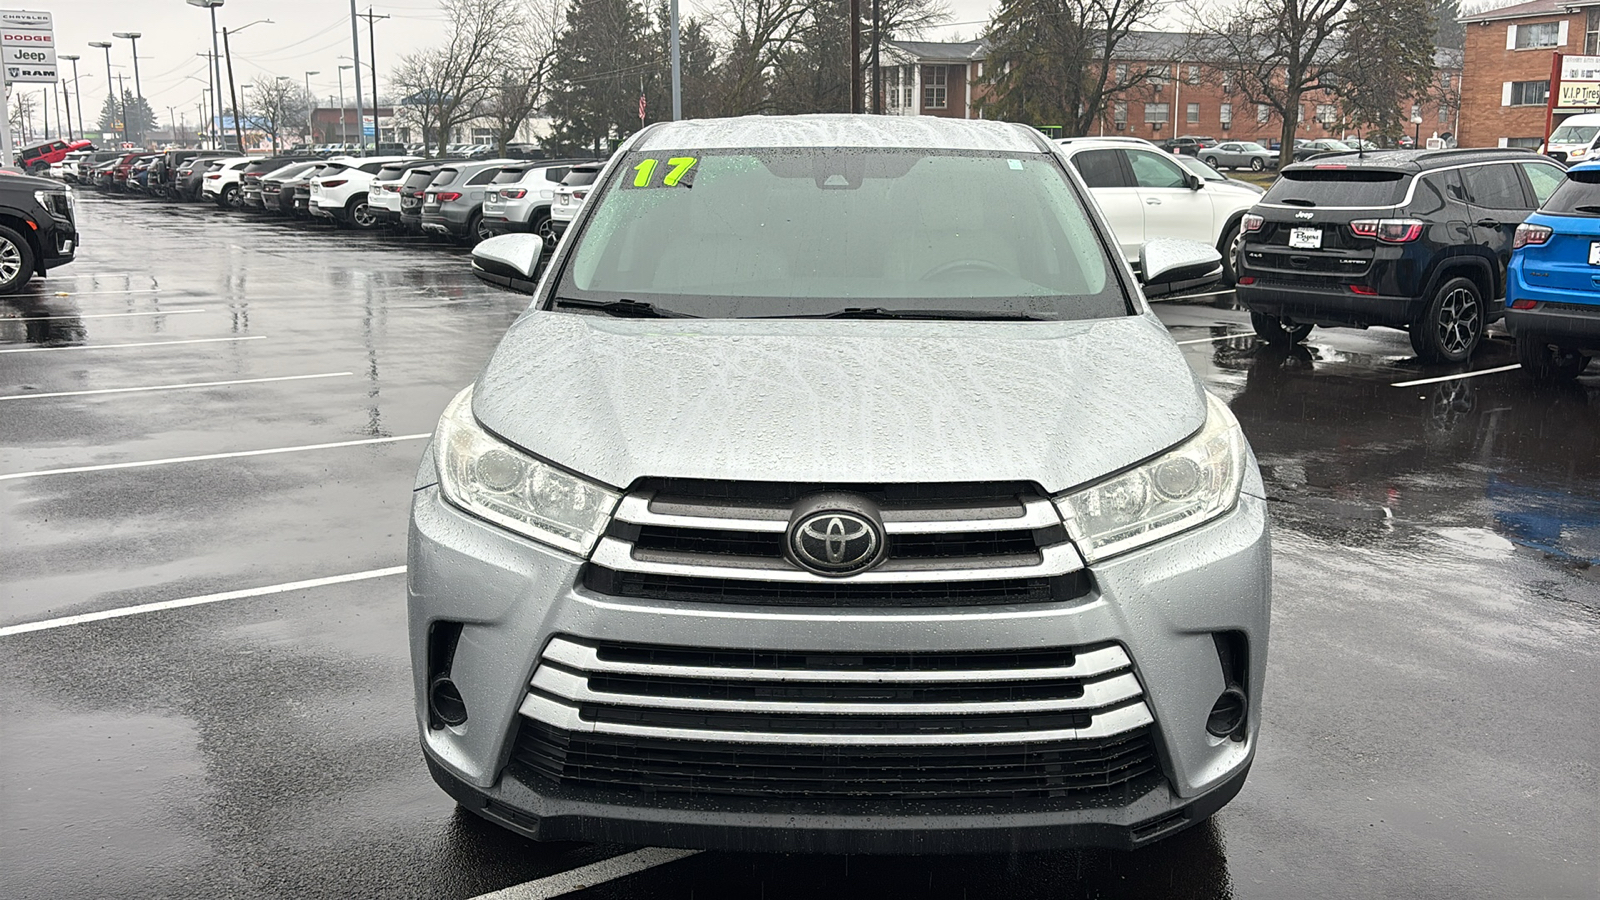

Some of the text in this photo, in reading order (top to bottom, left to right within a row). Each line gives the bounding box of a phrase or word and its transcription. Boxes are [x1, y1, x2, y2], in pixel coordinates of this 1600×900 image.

[14, 49, 46, 62] Jeep
[1582, 87, 1600, 99] Tires
[1295, 211, 1314, 220] Jeep
